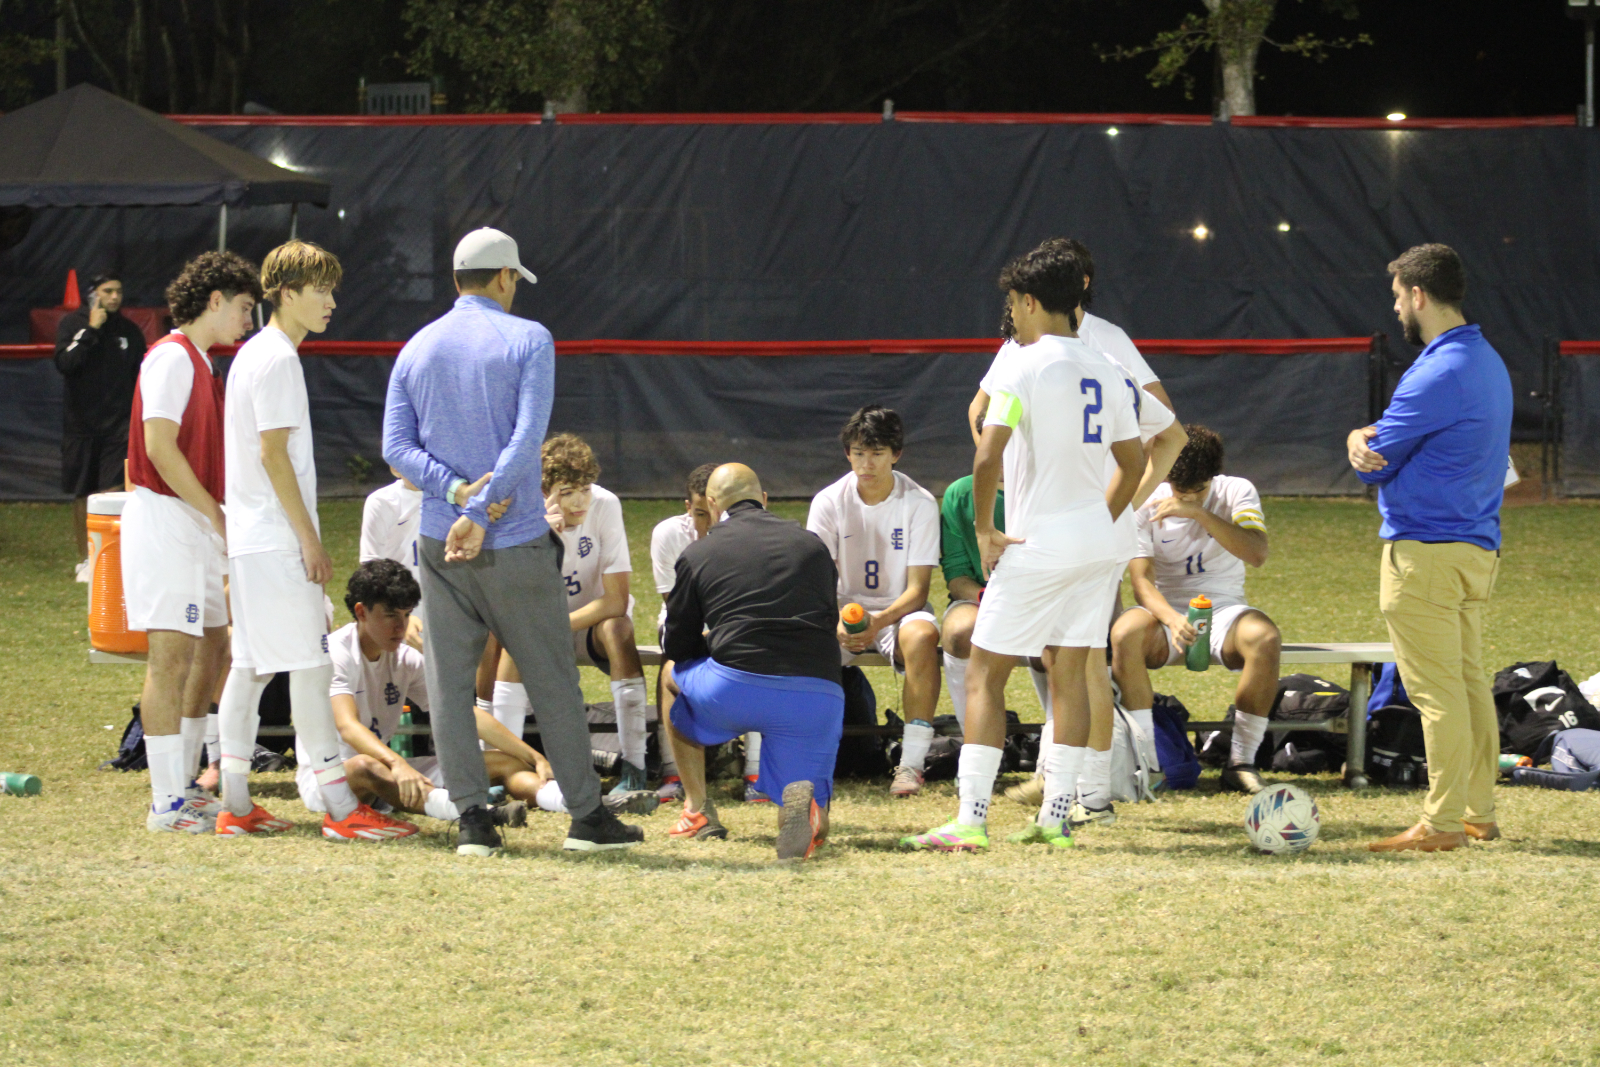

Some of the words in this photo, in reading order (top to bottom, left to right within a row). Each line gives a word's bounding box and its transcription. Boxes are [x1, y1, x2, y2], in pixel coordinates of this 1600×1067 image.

[1080, 378, 1103, 444] 2
[864, 560, 879, 591] 8
[1186, 552, 1206, 576] 11
[1557, 710, 1579, 730] 16
